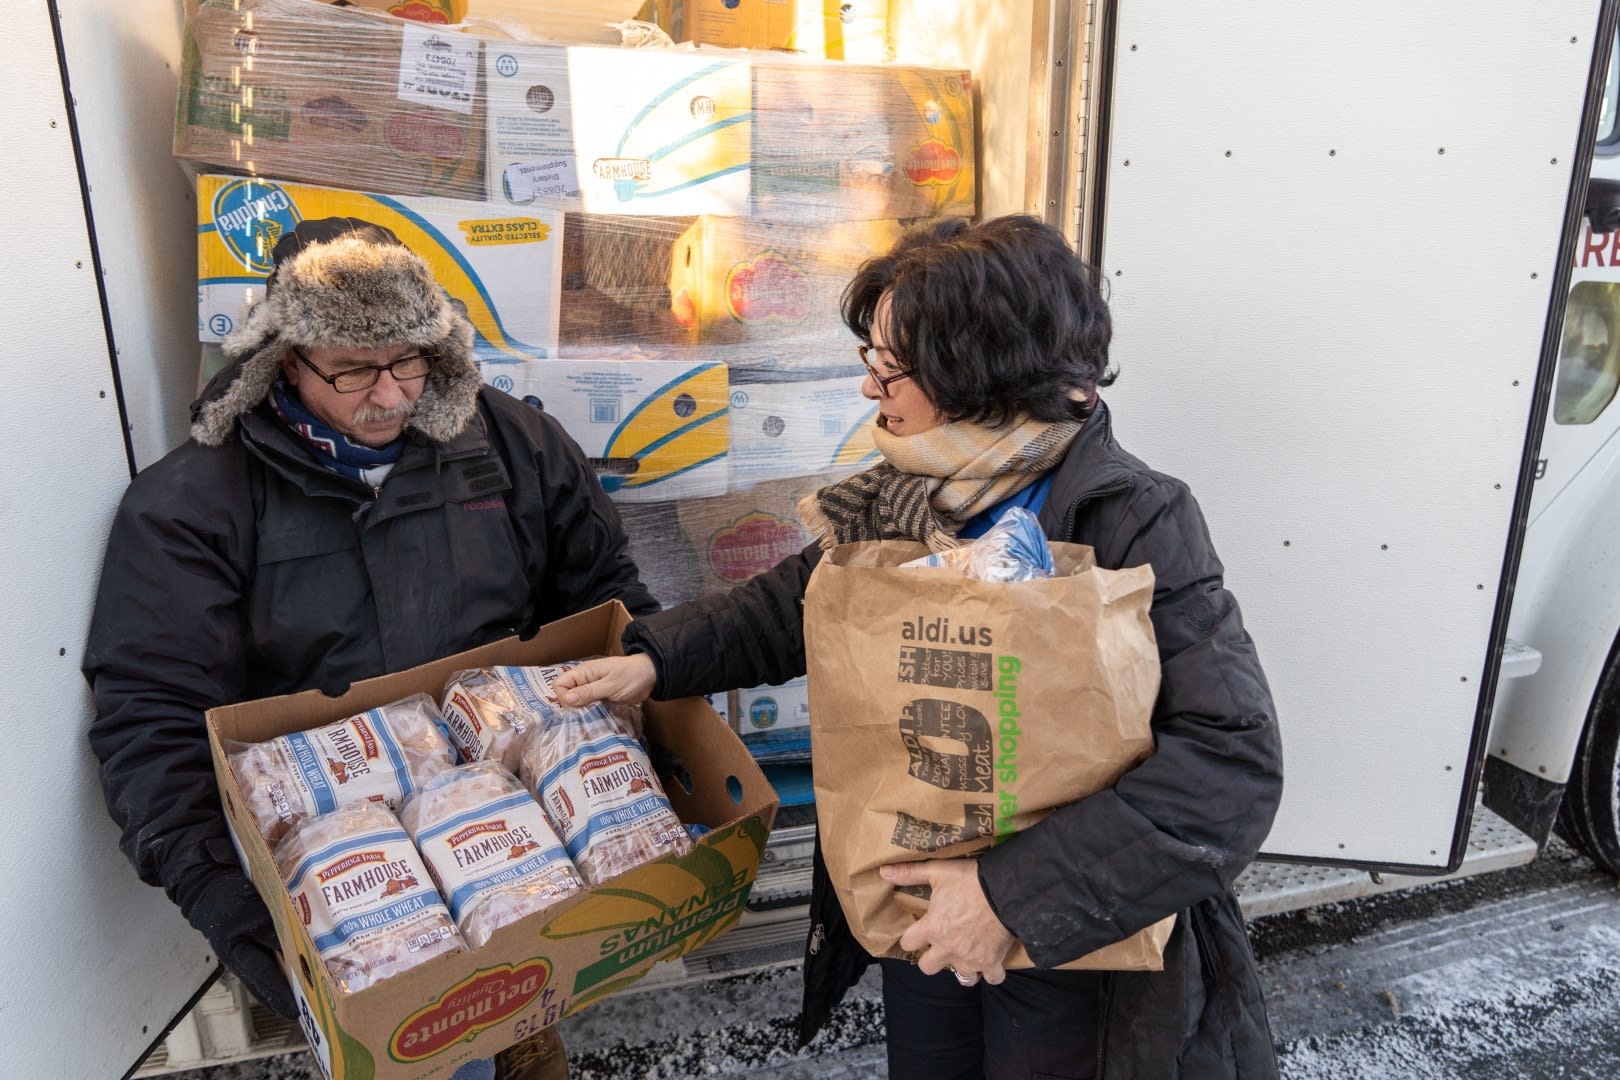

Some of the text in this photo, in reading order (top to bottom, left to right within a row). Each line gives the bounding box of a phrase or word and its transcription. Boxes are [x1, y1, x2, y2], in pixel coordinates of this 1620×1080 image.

[519, 160, 568, 174] Supplements
[532, 173, 560, 183] Dietary
[218, 190, 289, 232] Chiquita
[471, 222, 537, 233] CLASS EXTRA
[471, 232, 542, 242] SELECTED QUALITY
[1573, 225, 1620, 267] RE
[901, 616, 993, 647] aldi.us
[443, 703, 484, 760] FARMHOUSE
[993, 655, 1021, 783] shopping
[608, 754, 625, 764] FARM
[583, 762, 649, 798] FARMHOUSE
[612, 809, 638, 823] WHOLE
[451, 822, 503, 845] PEPPERIDGE FARM
[453, 825, 533, 868] FARMHOUSE
[321, 852, 382, 880] PEPPERIDGE FARM
[321, 859, 412, 906] FARMHOUSE
[491, 868, 521, 885] WHOLE
[521, 854, 550, 874] WHEAT
[340, 896, 425, 936] 100% WHOLE WHEAT
[617, 892, 741, 964] Premium
[403, 974, 538, 1049] Del Monte
